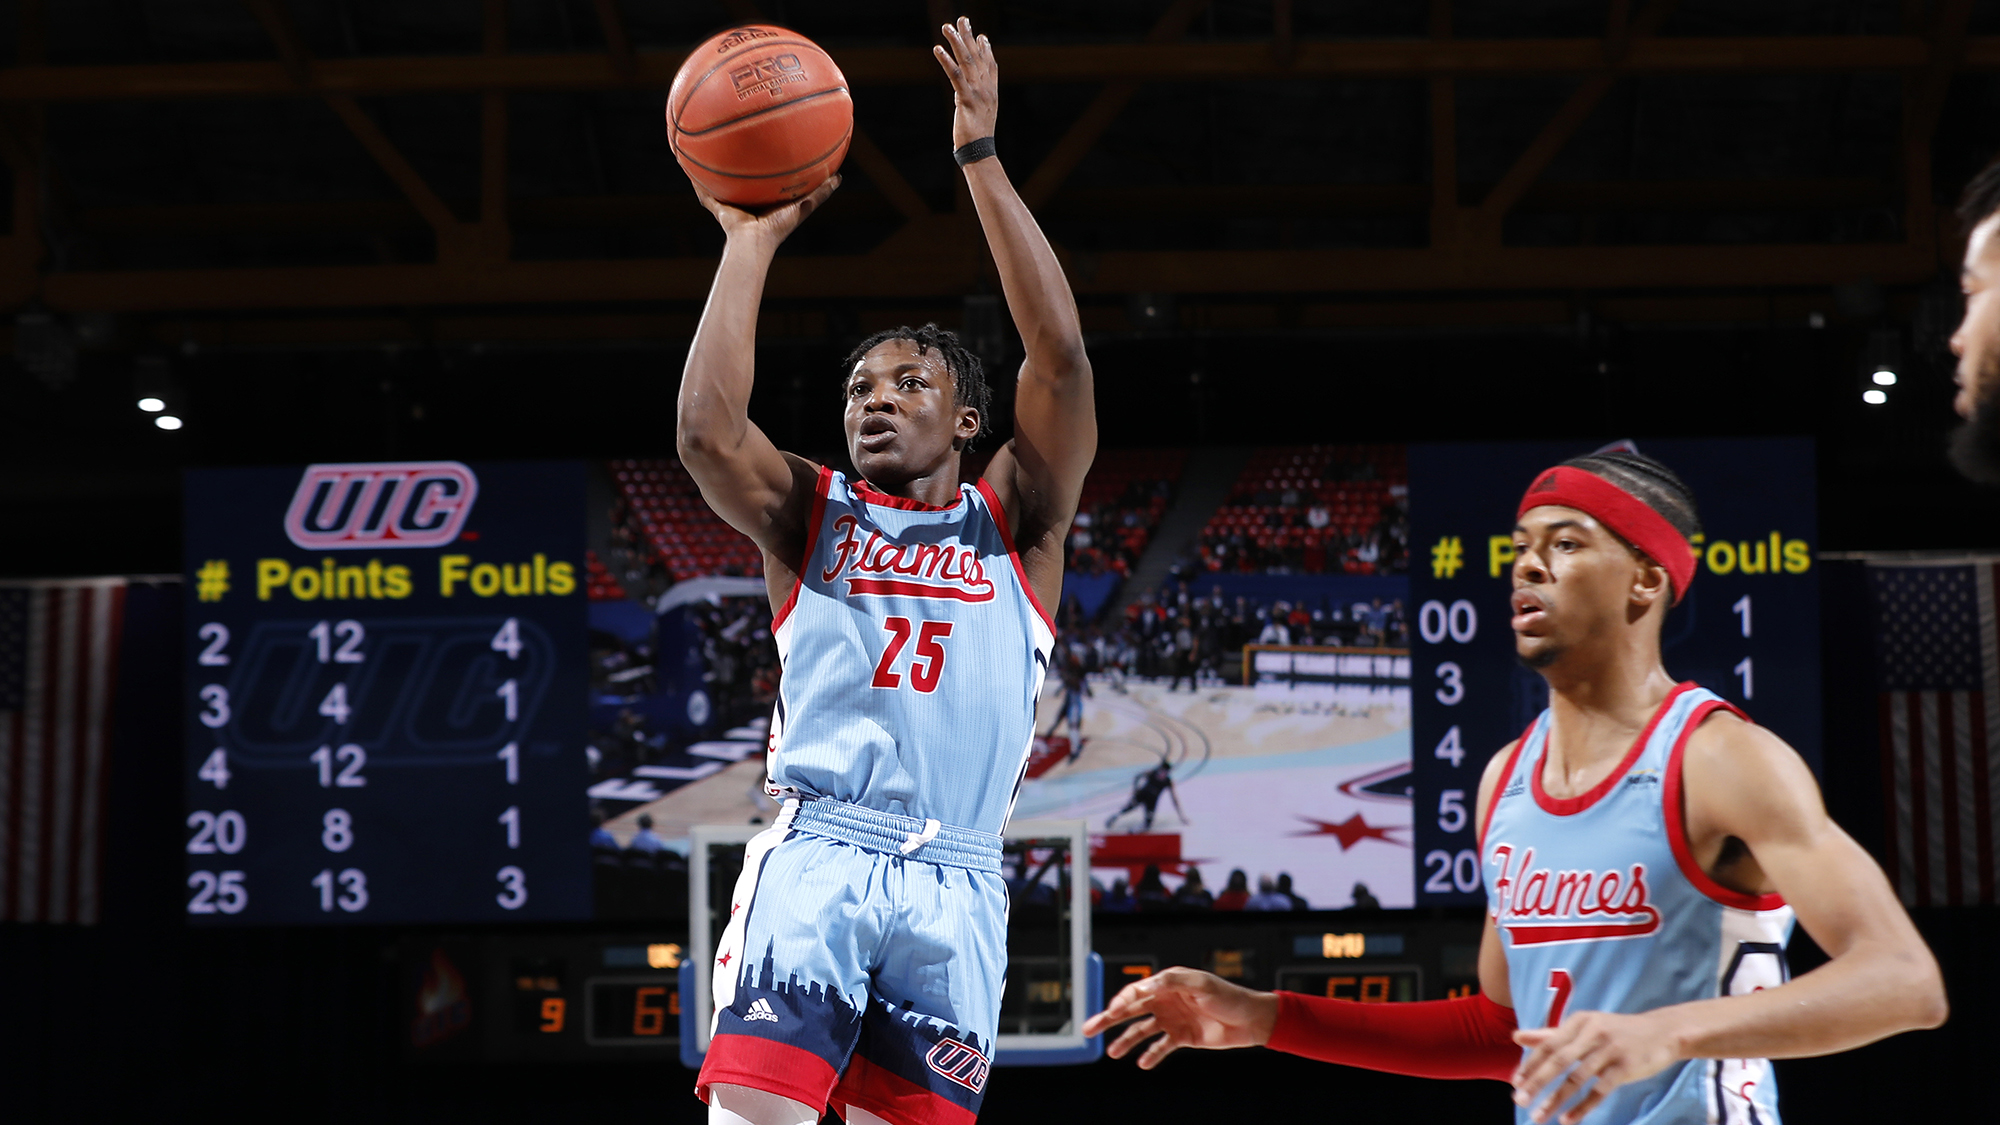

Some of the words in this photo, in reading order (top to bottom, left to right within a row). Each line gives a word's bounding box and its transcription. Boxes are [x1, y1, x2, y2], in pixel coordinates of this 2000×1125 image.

[717, 29, 779, 54] adidas
[728, 53, 802, 92] PRO
[290, 465, 472, 545] UIC
[821, 512, 994, 592] Flames
[1431, 537, 1463, 578] #
[197, 561, 229, 601] #
[257, 558, 413, 601] Points
[440, 553, 576, 597] Fouls
[1419, 600, 1477, 643] 00
[1733, 596, 1751, 637] 1
[199, 623, 228, 665] 2
[310, 620, 364, 663] 12
[492, 618, 522, 659] 4
[870, 615, 956, 694] 25
[1436, 662, 1464, 705] 3
[1735, 658, 1753, 699] 1
[201, 685, 230, 727] 3
[319, 684, 350, 723] 4
[497, 680, 517, 721] 1
[199, 749, 229, 787] 4
[311, 744, 366, 787] 12
[498, 743, 518, 783] 1
[1435, 726, 1465, 767] 4
[188, 811, 245, 853] 20
[323, 809, 352, 852] 8
[499, 808, 519, 847] 1
[1439, 790, 1467, 833] 5
[188, 871, 247, 913] 25
[313, 869, 368, 912] 13
[497, 866, 526, 909] 3
[1425, 849, 1480, 893] 20
[1490, 844, 1659, 928] Flames
[541, 998, 566, 1032] 9
[743, 1009, 779, 1023] adidas
[928, 1038, 991, 1092] UIC
